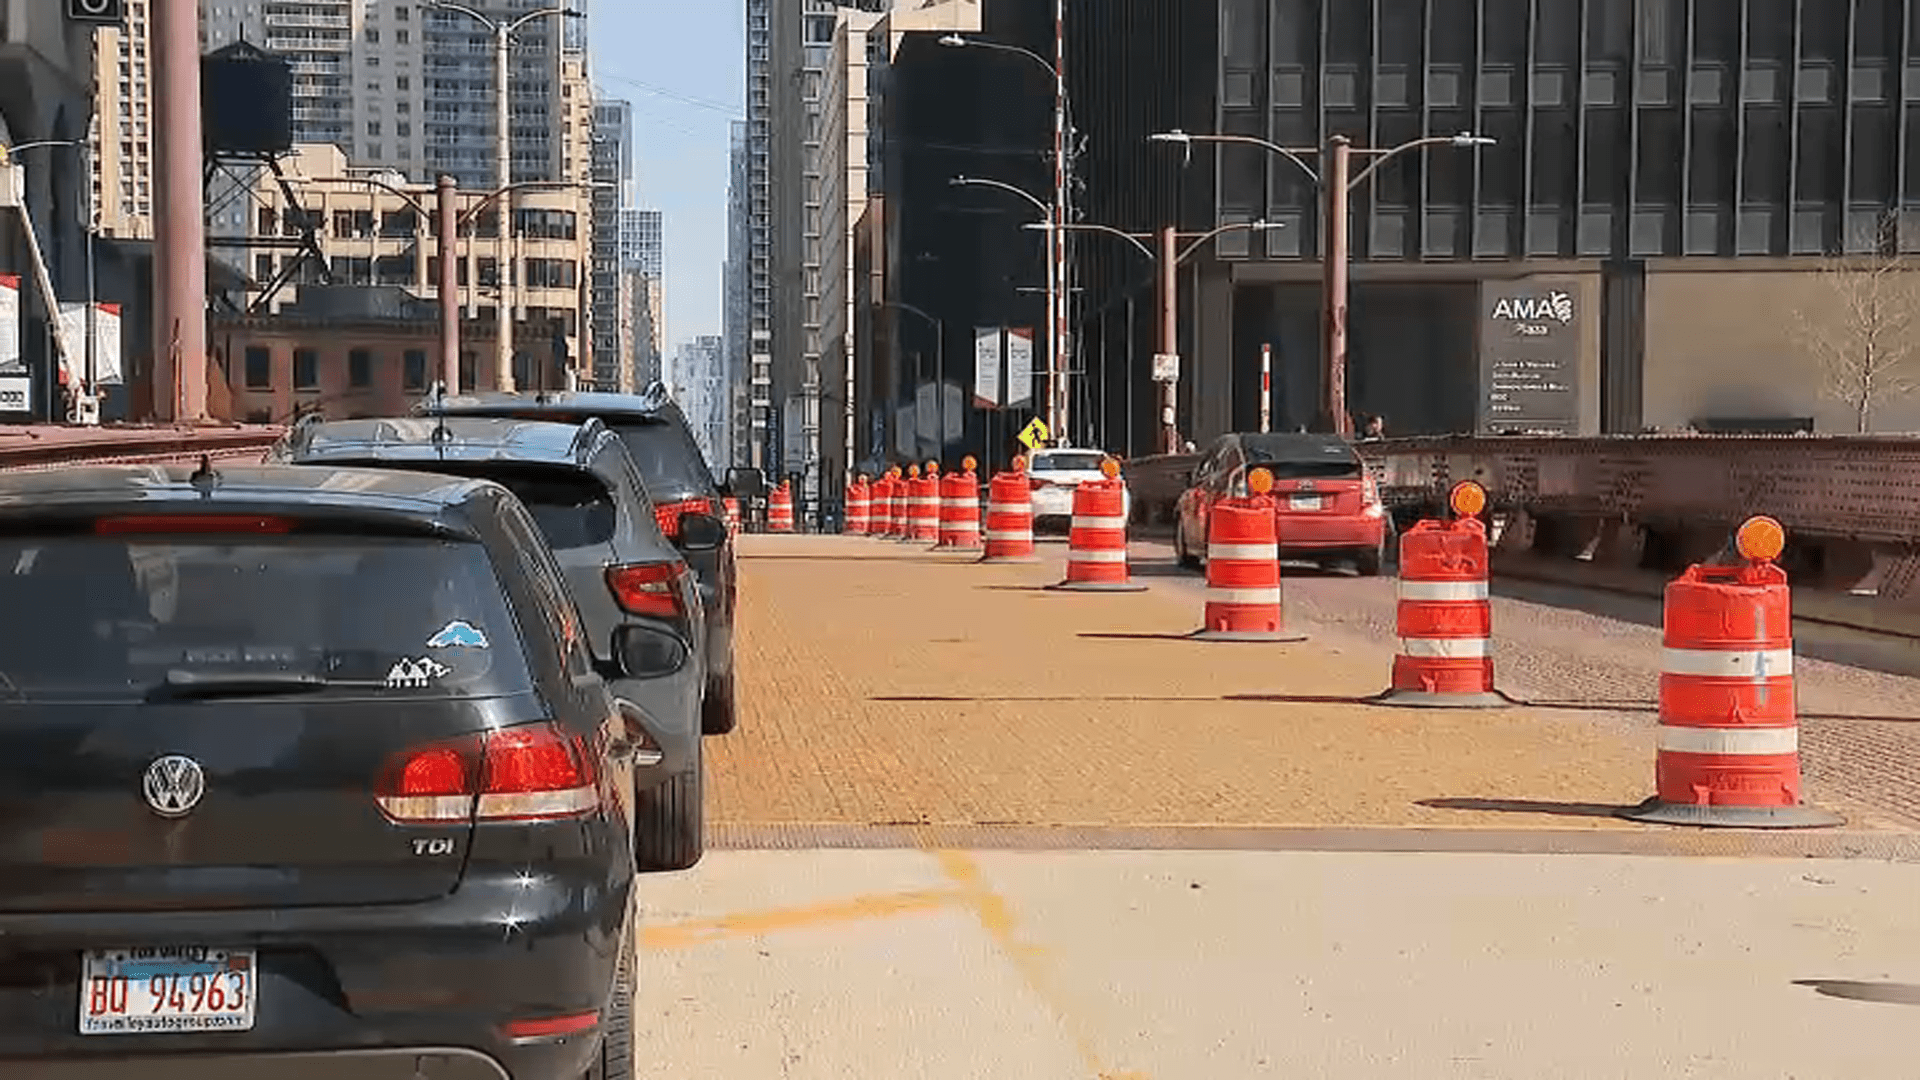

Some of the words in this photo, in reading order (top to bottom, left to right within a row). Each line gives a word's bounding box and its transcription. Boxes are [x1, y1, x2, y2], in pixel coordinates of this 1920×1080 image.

[1492, 299, 1556, 319] AMA
[411, 838, 454, 855] TDI
[149, 972, 245, 1014] 94963
